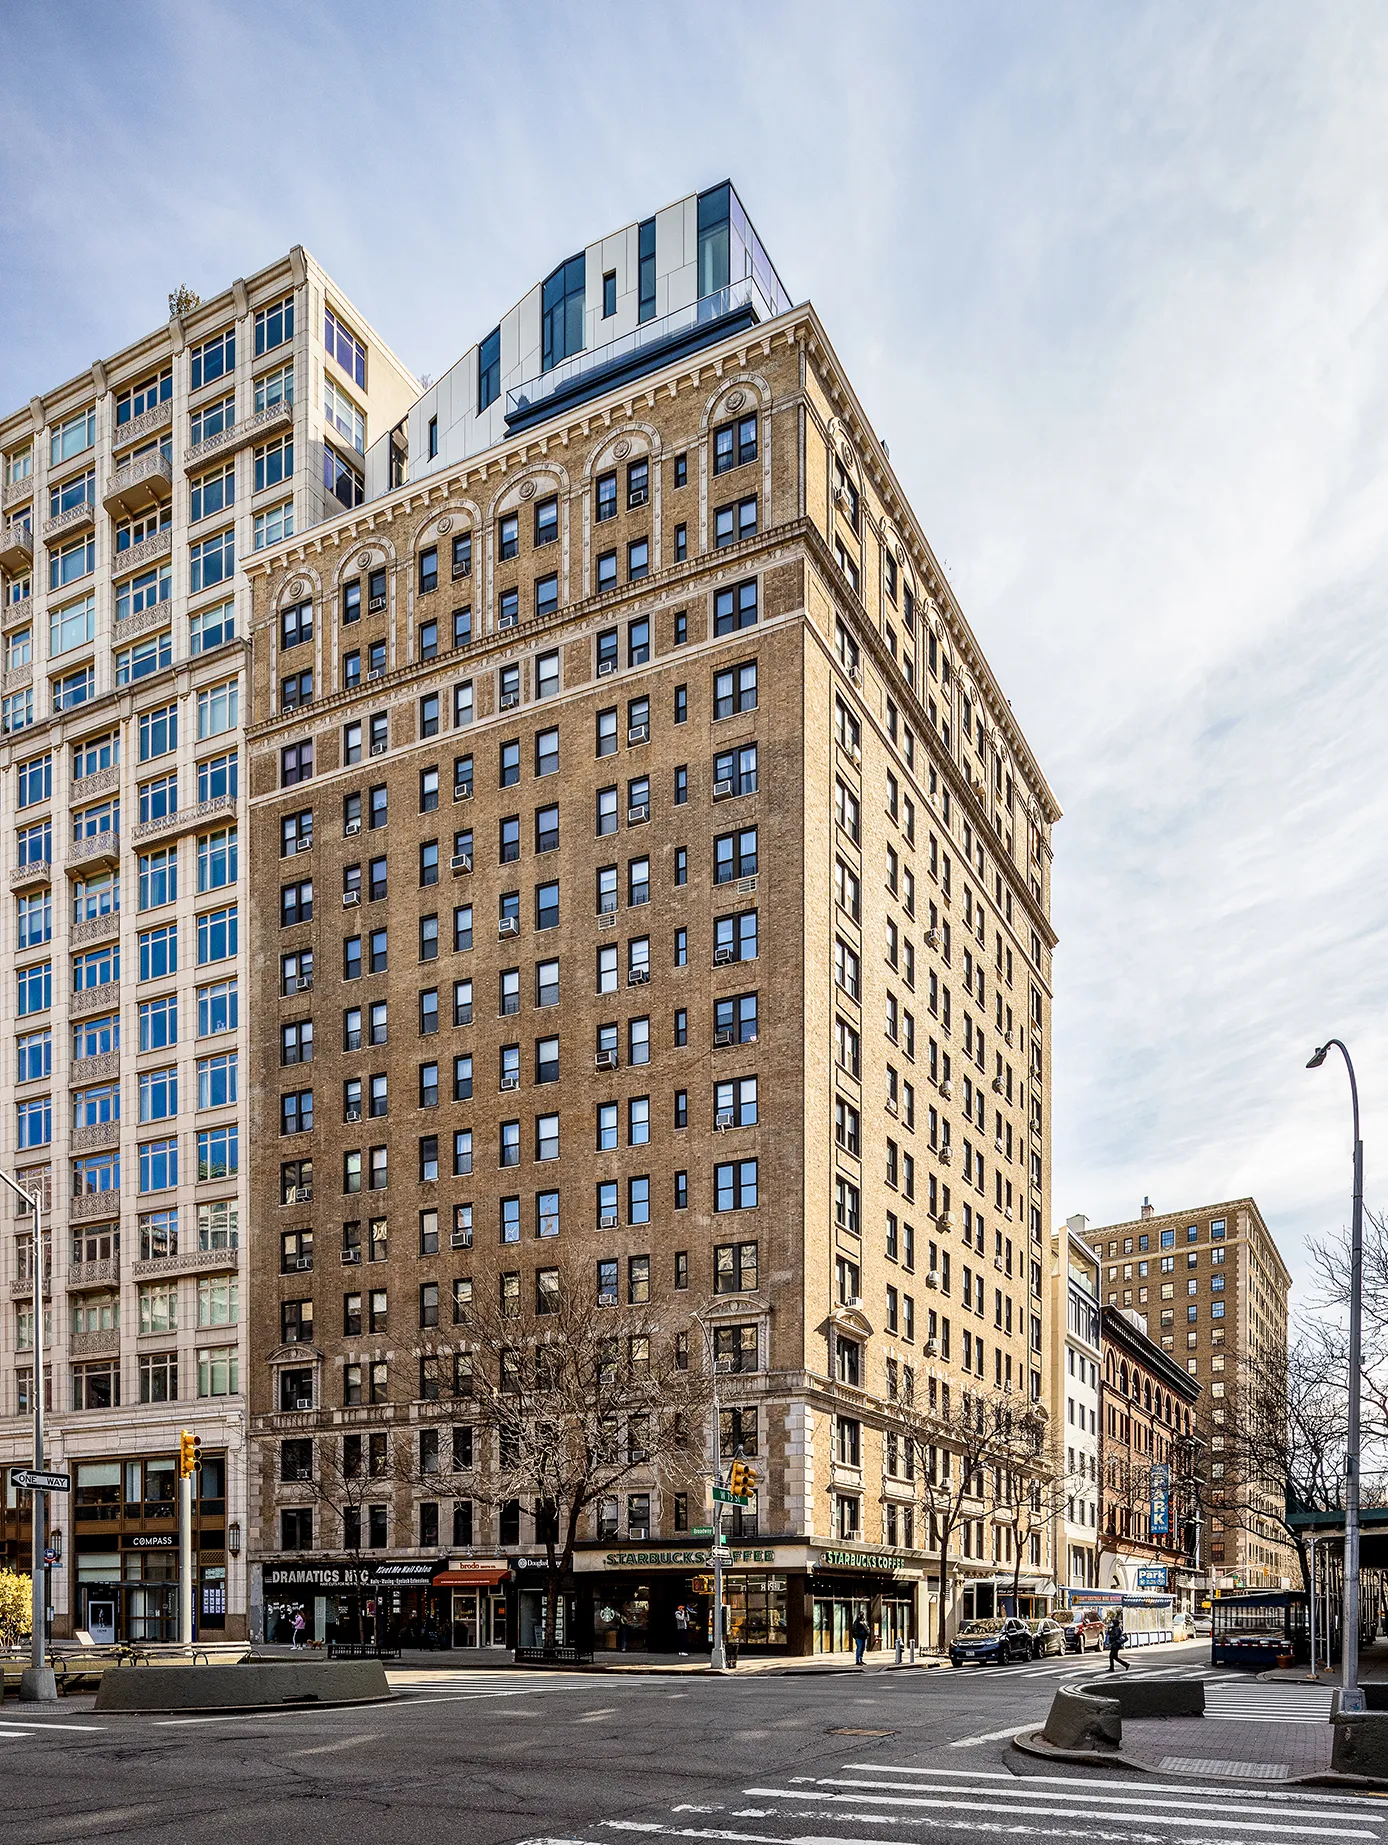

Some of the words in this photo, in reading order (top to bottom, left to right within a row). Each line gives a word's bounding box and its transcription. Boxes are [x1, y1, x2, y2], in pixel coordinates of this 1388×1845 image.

[19, 1474, 37, 1484] ONE
[46, 1477, 66, 1486] WAY
[133, 1536, 173, 1546] COMPASS
[606, 1552, 705, 1565] STARBUCKS
[705, 1550, 774, 1564] FFEE
[826, 1550, 877, 1568] STARBUCKS
[877, 1556, 905, 1569] COFFEE
[401, 1565, 416, 1574] Nail
[414, 1564, 432, 1573] Salon
[1139, 1570, 1165, 1579] Park
[272, 1569, 340, 1584] DRAMATICS
